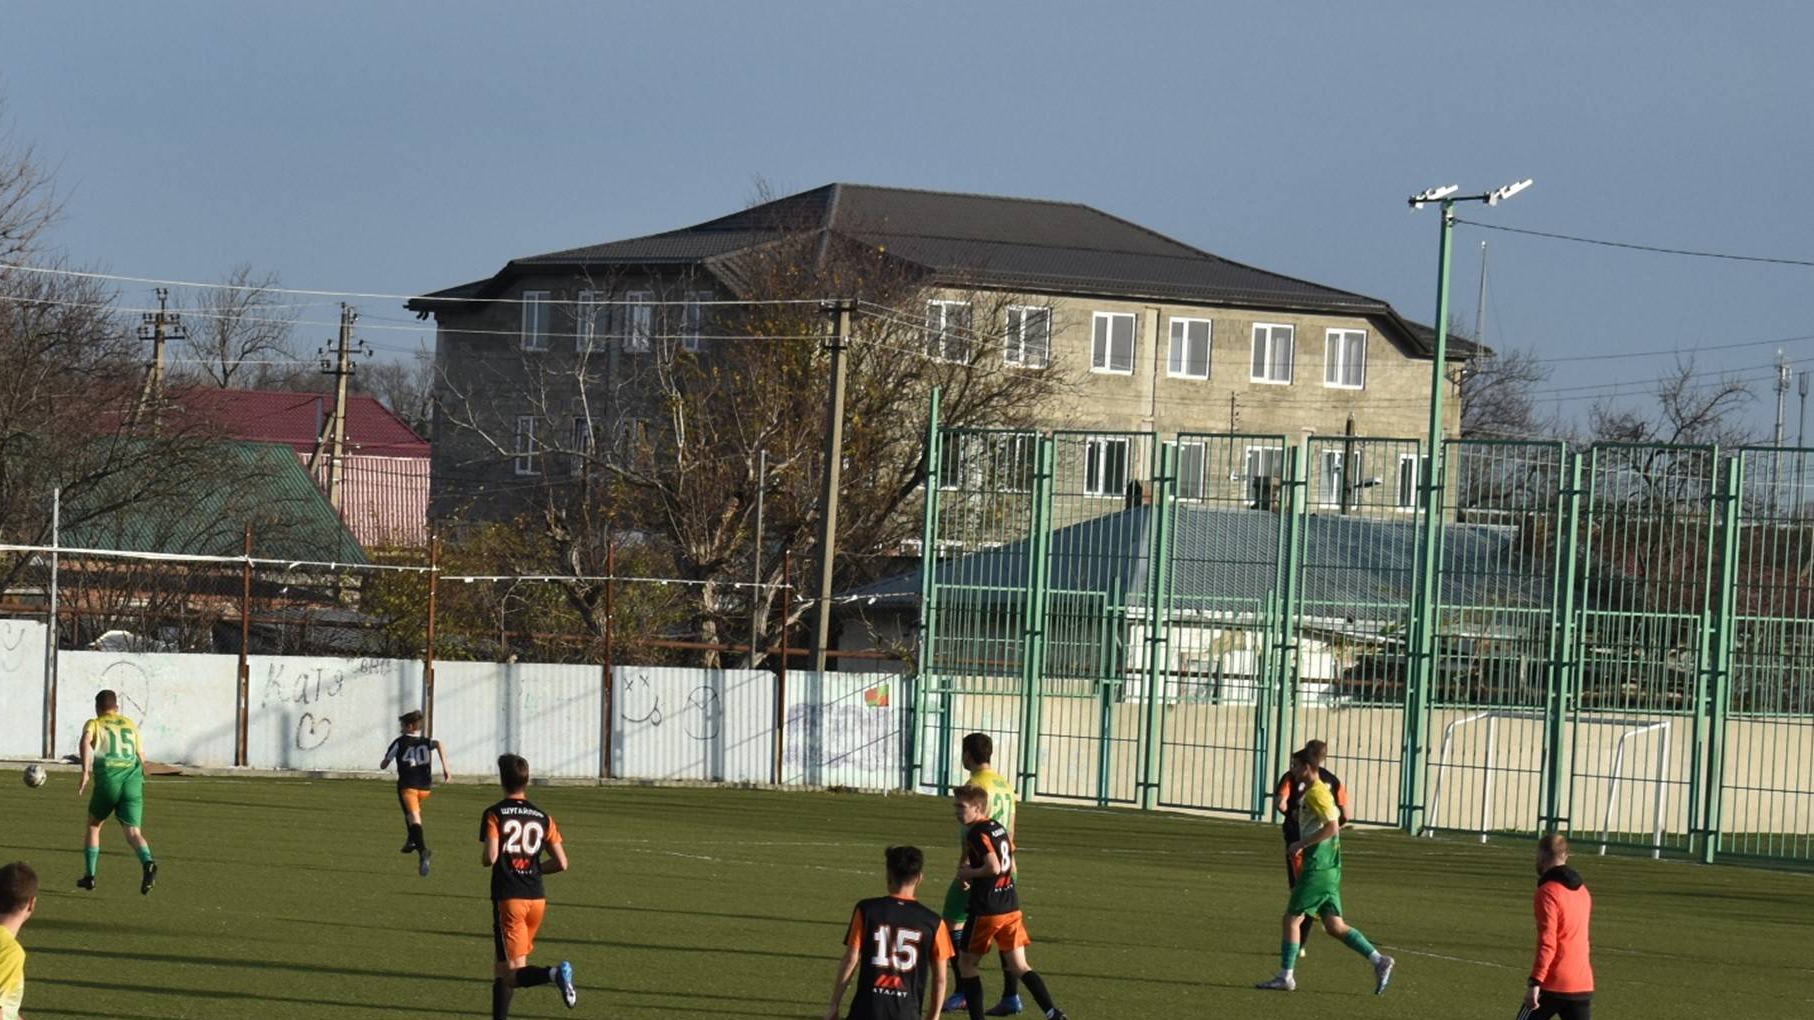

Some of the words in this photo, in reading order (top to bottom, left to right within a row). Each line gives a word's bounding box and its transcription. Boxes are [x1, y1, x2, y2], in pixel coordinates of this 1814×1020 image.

[104, 724, 137, 760] 15
[401, 744, 430, 767] 40
[503, 819, 544, 855] 20
[1000, 840, 1011, 873] 8
[871, 924, 922, 972] 15
